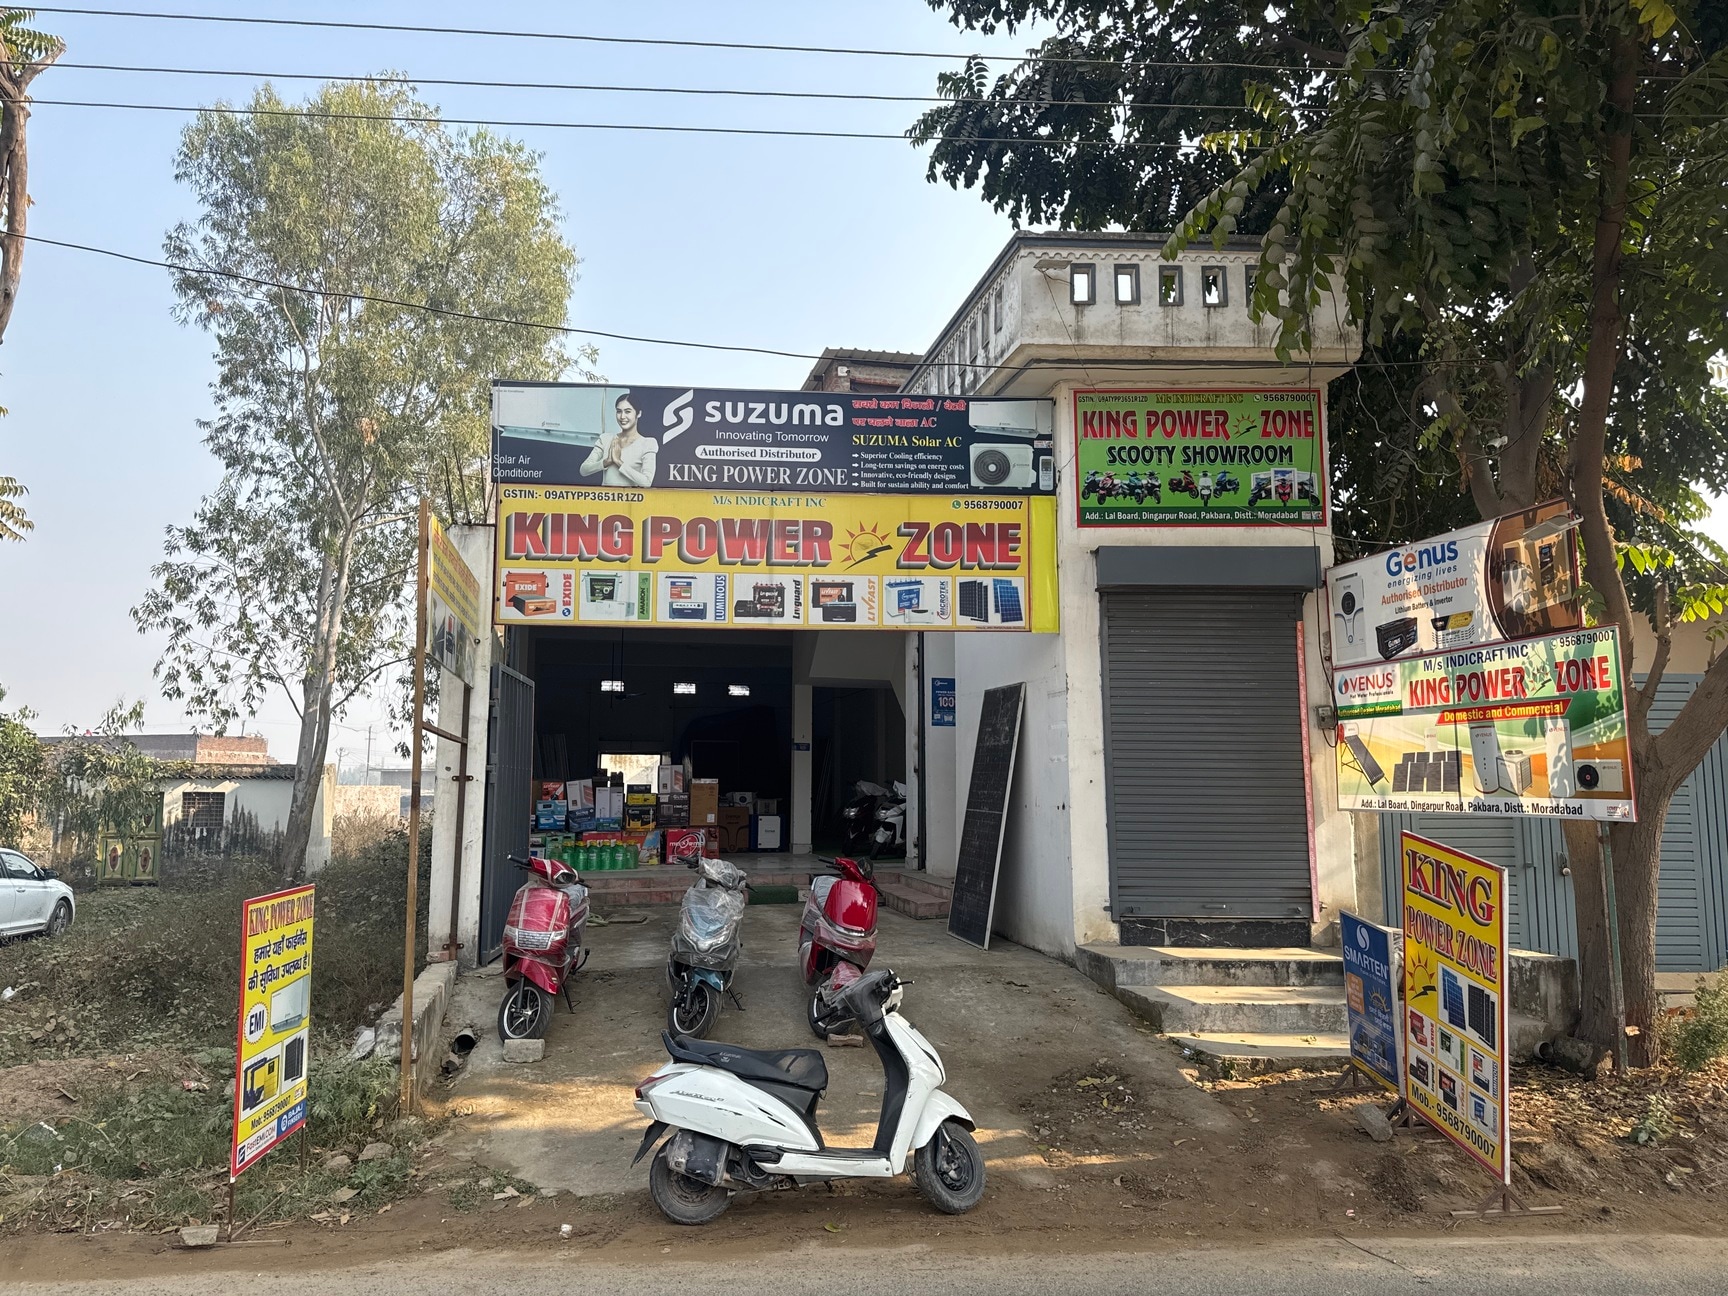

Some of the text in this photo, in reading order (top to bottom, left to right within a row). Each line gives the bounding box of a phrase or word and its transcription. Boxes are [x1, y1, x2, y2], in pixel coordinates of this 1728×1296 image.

[1226, 394, 1244, 404] INC
[1263, 394, 1316, 402] 9568790007
[920, 417, 937, 428] AC
[1082, 409, 1315, 441] KING POWER ZONE
[716, 430, 829, 442] Innovating Tomorrow
[852, 434, 962, 448] SUZUMA Solar AC
[493, 454, 531, 465] Solar Air
[700, 447, 818, 460] Authorised Distributor
[860, 452, 943, 462] Superior Cooling efficiency
[1107, 444, 1293, 468] SCOOTY SHOWROOM
[493, 467, 543, 478] Conditioner
[668, 464, 848, 486] KING POWER ZONE
[860, 462, 894, 470] Long-term
[895, 463, 917, 471] savings
[860, 472, 956, 481] Innovative, eco-friendly designs
[860, 480, 876, 488] Built
[876, 480, 886, 488] for
[910, 482, 928, 490] ability
[940, 482, 969, 490] comfort
[544, 490, 644, 503] 09ATYPP3651R1ZD
[712, 495, 827, 508] M/s INDICRAFT INC
[964, 500, 1024, 510] 9568790007
[1105, 512, 1116, 520] Lal
[1118, 512, 1141, 521] Board,
[1142, 511, 1177, 521] Dingarpur
[1178, 512, 1200, 520] Road,
[1200, 511, 1233, 520] Pakbara,
[1258, 511, 1299, 519] Moradabad
[505, 512, 1022, 571] KING POWER ZONE
[1386, 540, 1458, 576] Genus
[1388, 564, 1458, 588] energizing lives
[562, 574, 572, 606] EXIDE
[716, 576, 724, 620] LUMINOUS
[792, 579, 802, 620] Livguard
[1381, 577, 1468, 606] Authorised Distributor
[1429, 598, 1434, 607] &
[1559, 630, 1616, 648] 9568790007
[1423, 644, 1529, 673] M/s INDICRAFT INC
[1350, 672, 1393, 692] VENUS
[1409, 656, 1612, 706] KING POWER ZONE
[1444, 702, 1564, 722] Domestic and Commercial
[1378, 800, 1387, 809] Lal
[1388, 800, 1409, 811] Board,
[1410, 801, 1444, 813] Dingarpur
[1468, 802, 1502, 814] Pakbara,
[1532, 804, 1583, 816] Moradabad
[1406, 848, 1496, 926] KING
[248, 893, 314, 937] KING POWER ZONE
[254, 940, 272, 964] हमारे
[272, 934, 285, 956] यहाँ
[1406, 905, 1498, 984] POWER ZONE
[1344, 945, 1388, 980] SMARTEN
[248, 970, 258, 991] की
[260, 964, 280, 994] सुविधा
[249, 1009, 264, 1035] EMI
[1436, 1102, 1496, 1160] 9568790007
